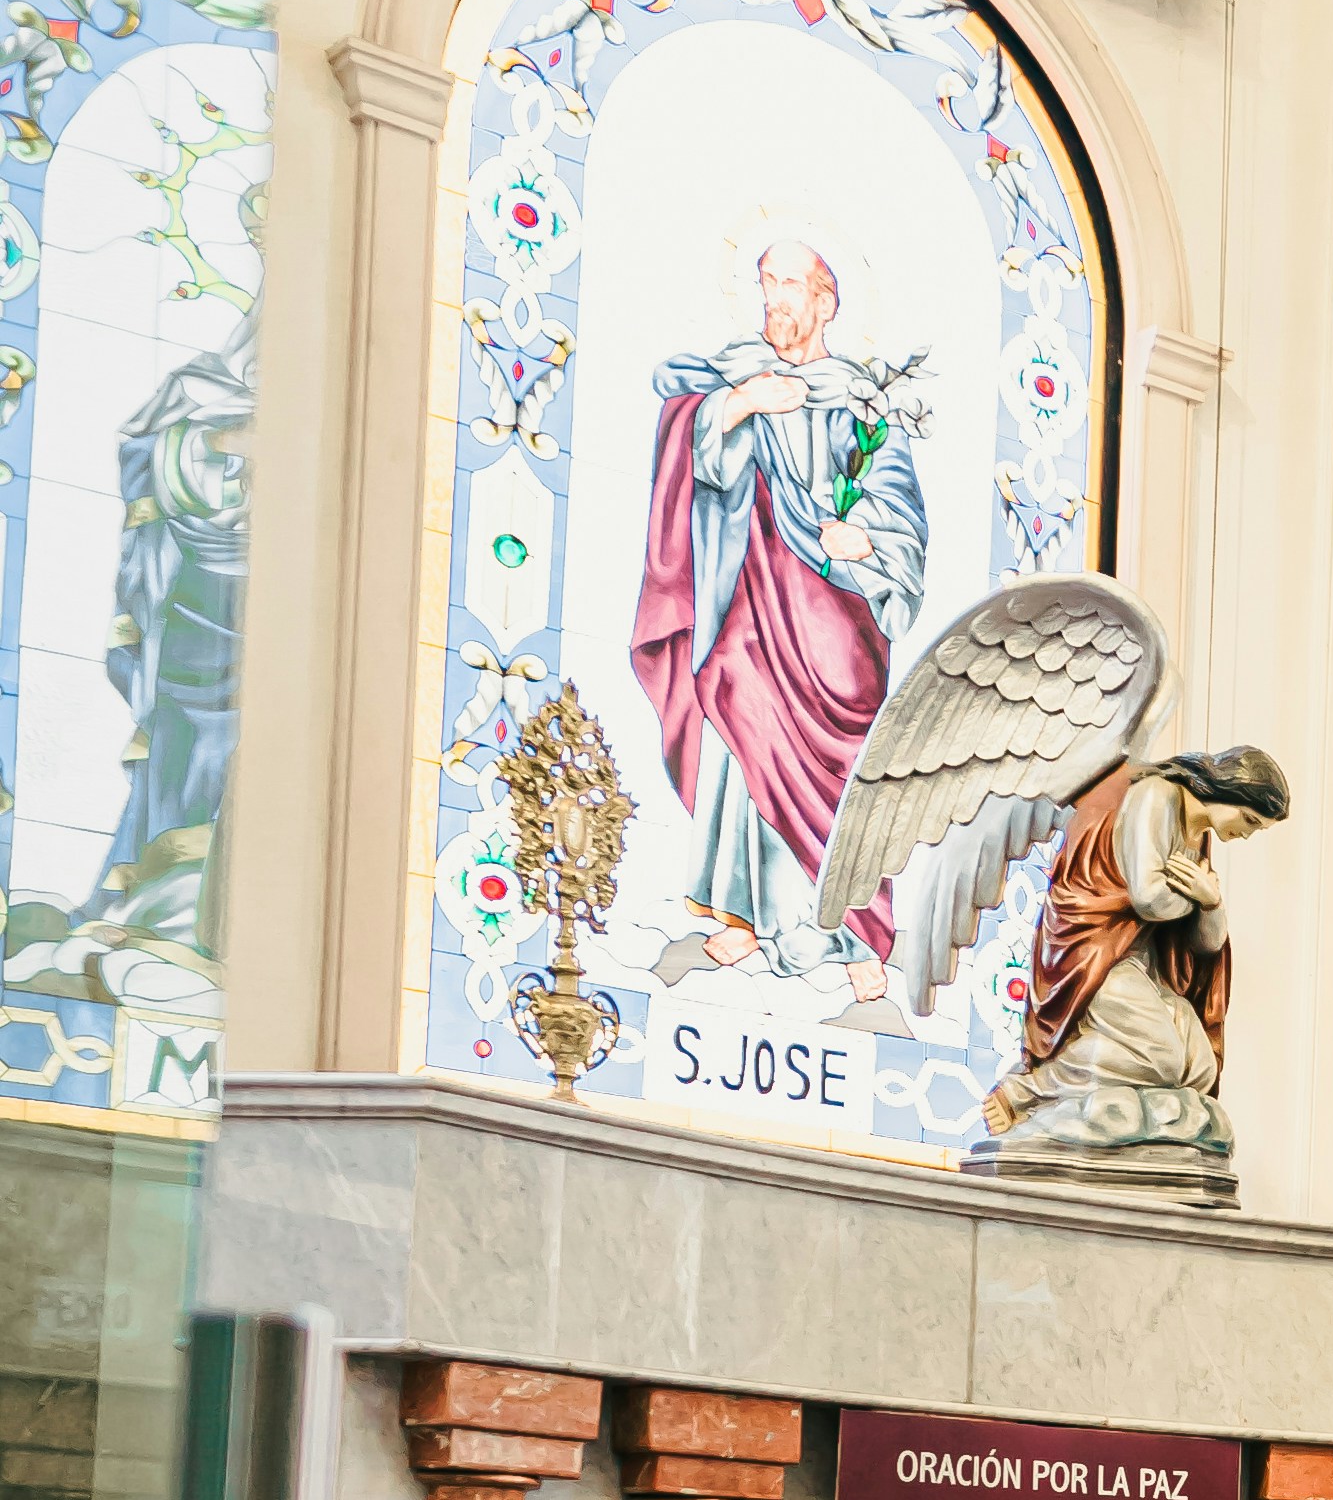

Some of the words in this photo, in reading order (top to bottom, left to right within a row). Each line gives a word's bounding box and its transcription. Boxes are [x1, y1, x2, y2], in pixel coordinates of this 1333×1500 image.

[897, 1449, 1021, 1489] ORACIÓN
[1033, 1460, 1088, 1494] POR
[1098, 1465, 1130, 1497] LA
[1140, 1468, 1188, 1500] PAZ
